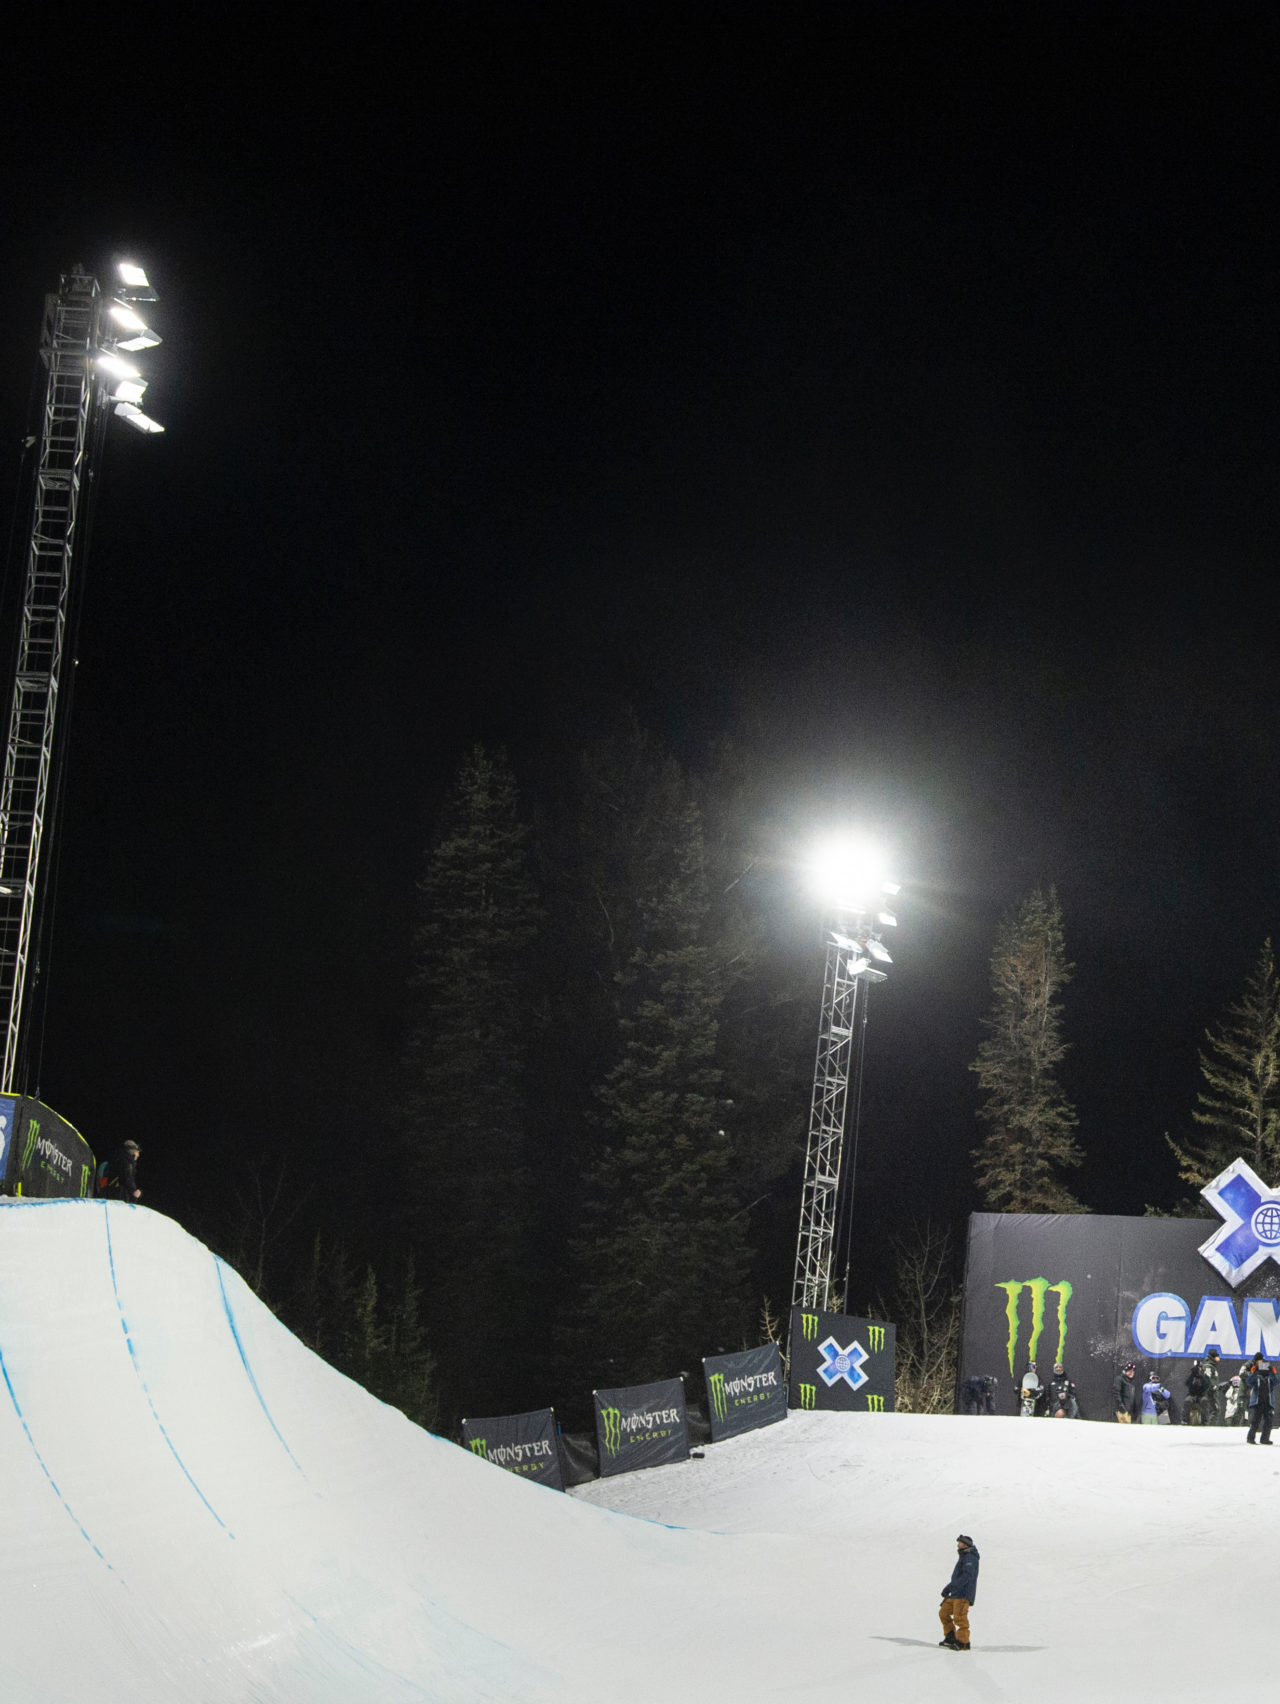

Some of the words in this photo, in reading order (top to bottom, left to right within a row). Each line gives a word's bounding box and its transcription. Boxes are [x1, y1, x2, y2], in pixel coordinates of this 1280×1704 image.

[724, 1371, 777, 1397] MONSTER
[621, 1408, 680, 1433] MONSTER
[487, 1440, 552, 1465] MONSTER
